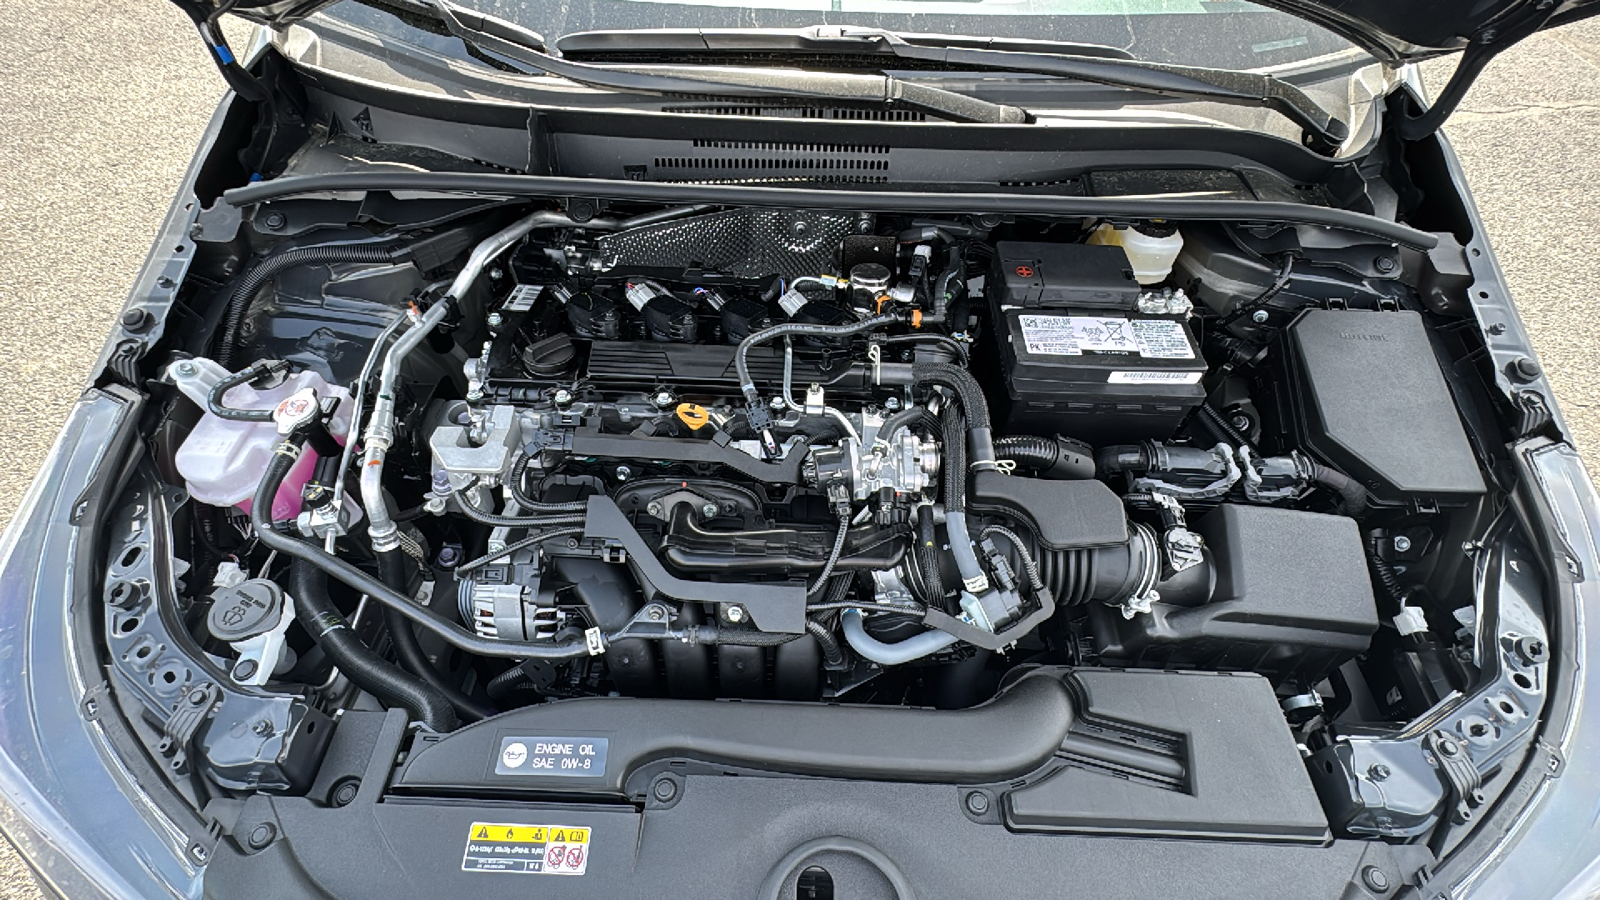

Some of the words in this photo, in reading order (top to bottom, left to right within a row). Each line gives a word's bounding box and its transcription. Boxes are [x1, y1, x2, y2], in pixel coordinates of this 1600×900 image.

[534, 743, 574, 755] ENGINE
[578, 744, 596, 756] OIL
[532, 757, 555, 769] SAE
[561, 758, 592, 769] 0W-8
